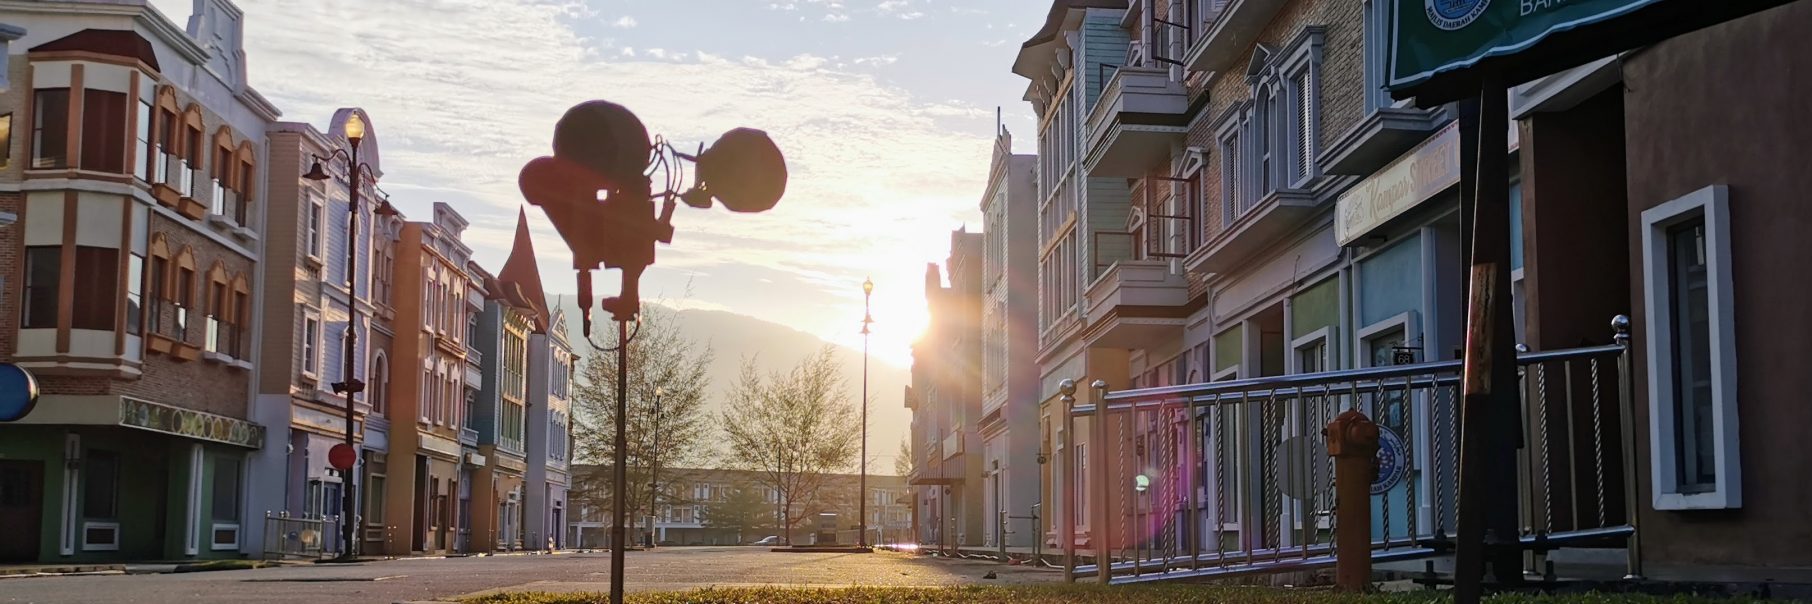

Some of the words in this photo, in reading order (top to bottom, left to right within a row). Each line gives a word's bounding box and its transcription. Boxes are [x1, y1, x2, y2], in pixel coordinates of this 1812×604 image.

[1443, 16, 1471, 28] DAERAH
[1409, 141, 1453, 193] STREET
[1398, 354, 1410, 365] 68
